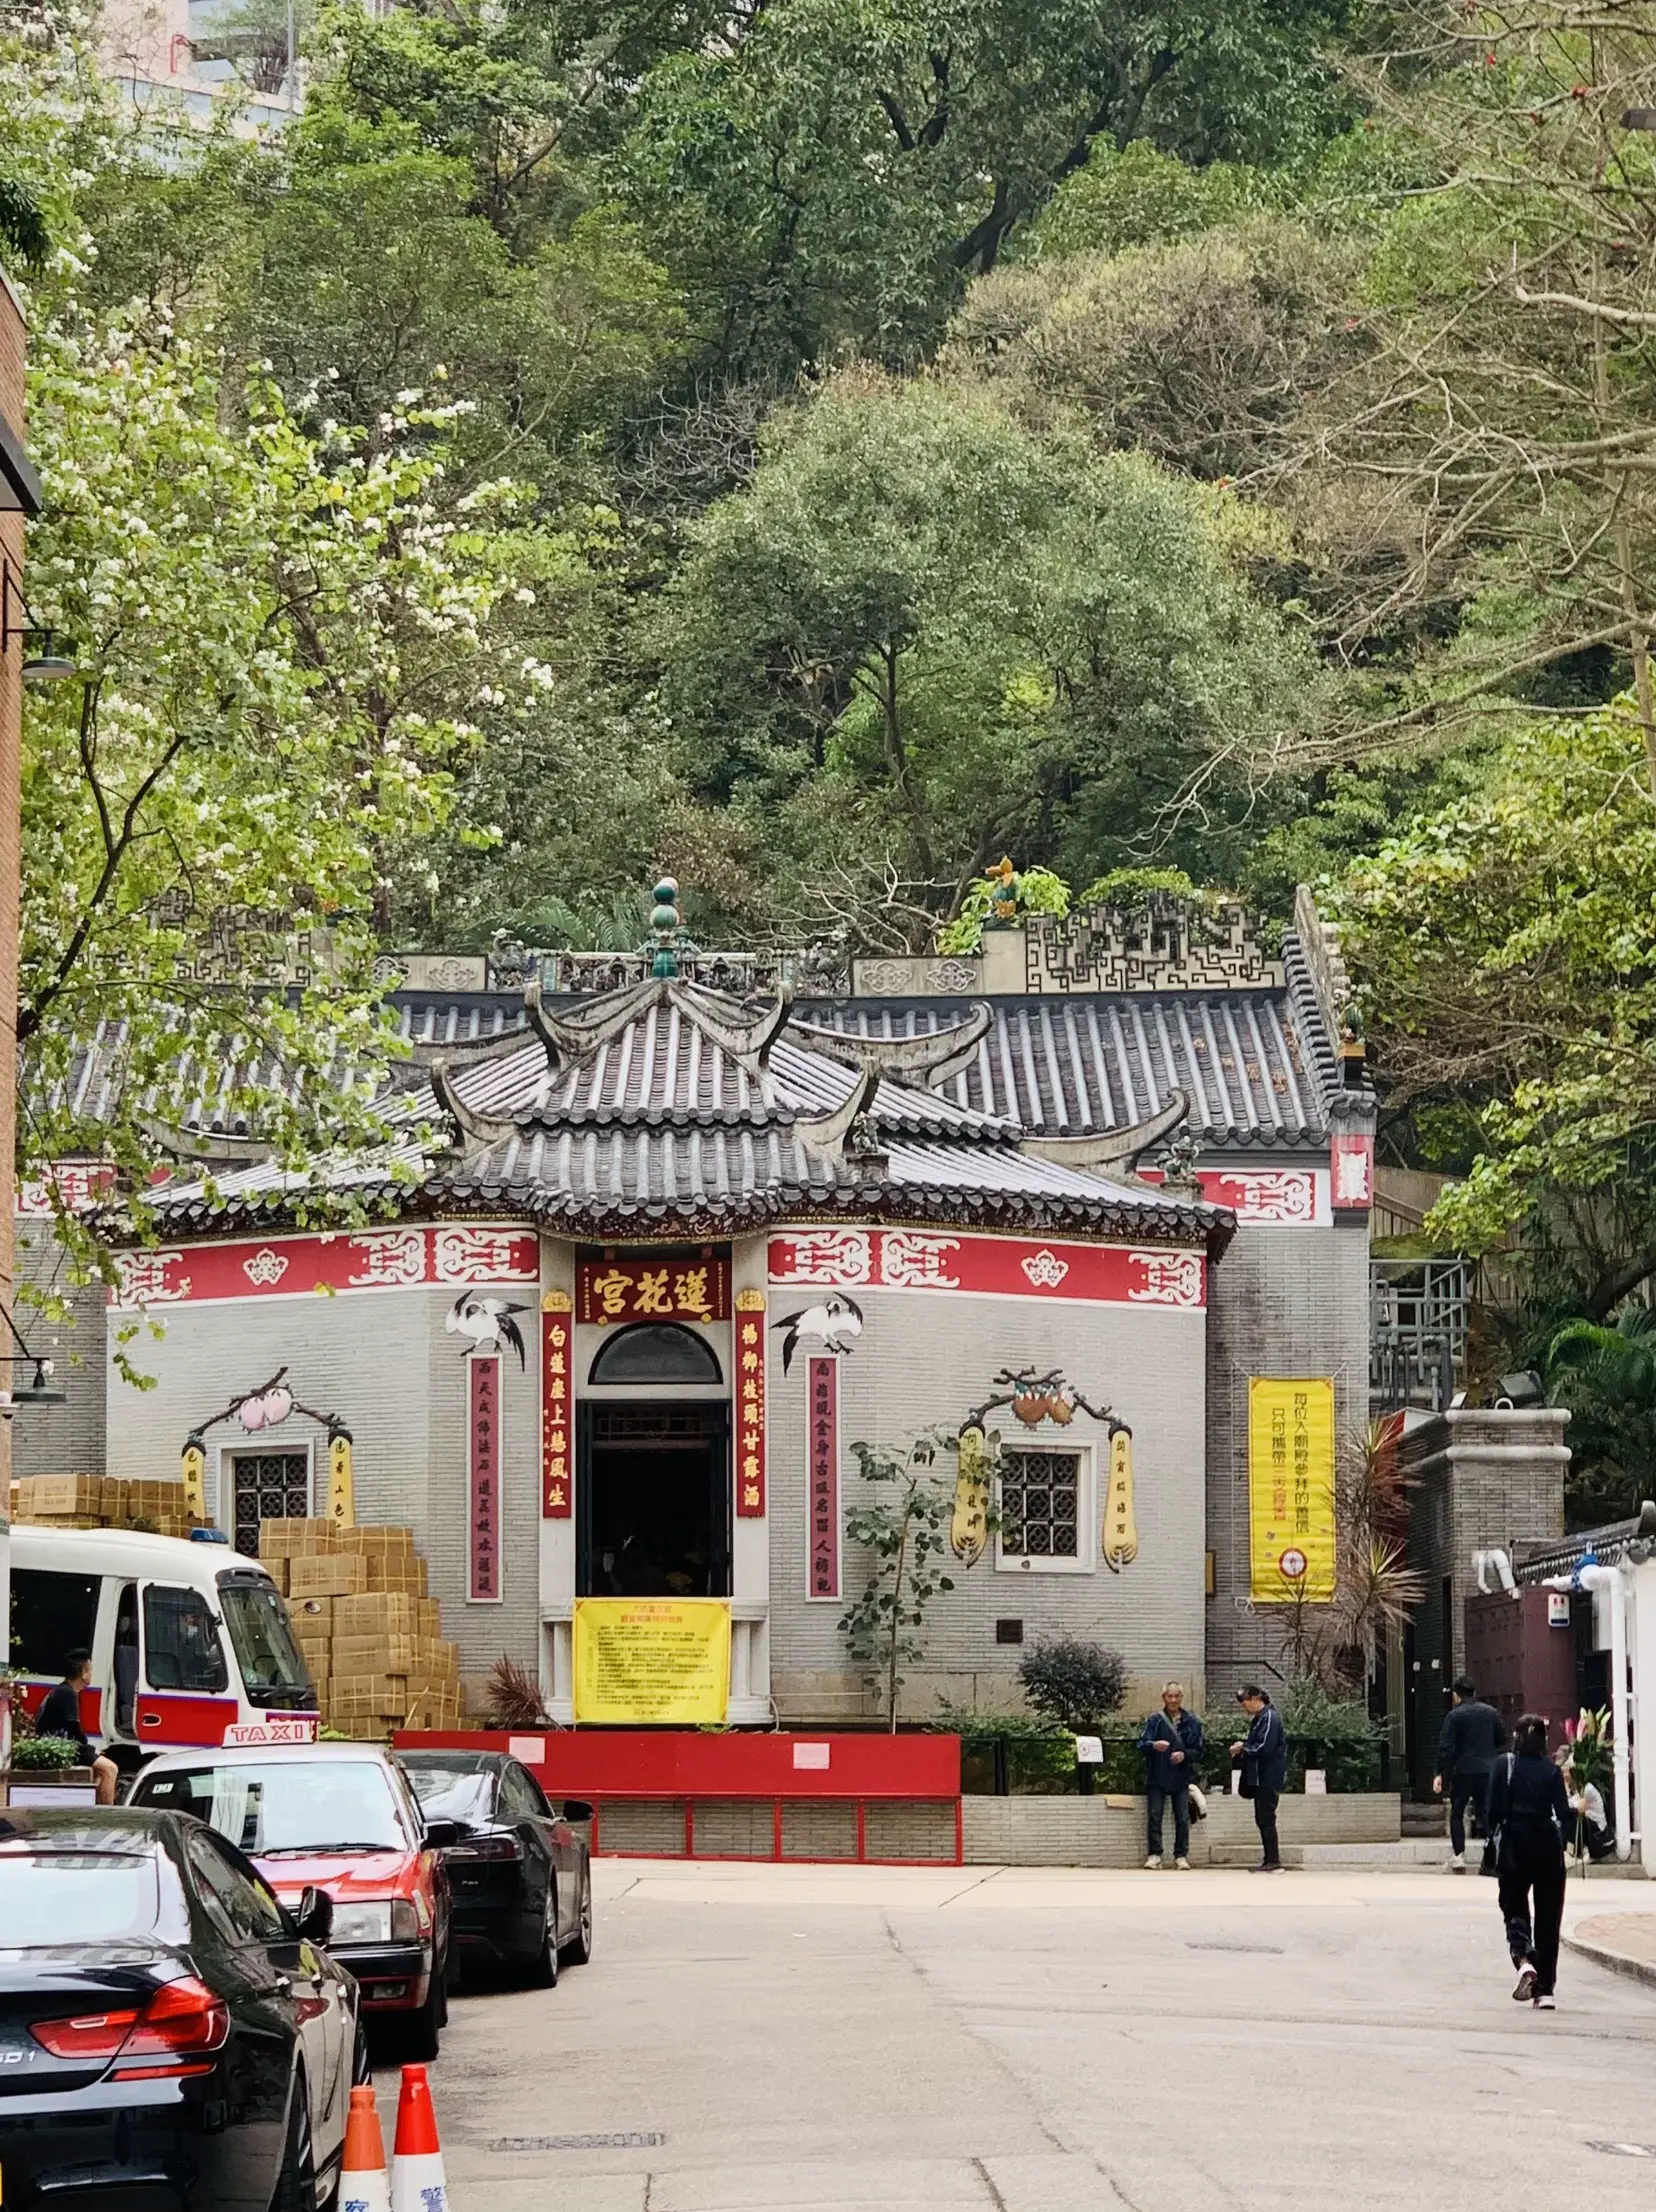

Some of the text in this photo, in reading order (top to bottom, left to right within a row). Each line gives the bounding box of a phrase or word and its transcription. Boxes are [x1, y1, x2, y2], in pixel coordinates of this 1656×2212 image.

[594, 1266, 715, 1314] 蓮花宮
[231, 1724, 304, 1742] TAXI
